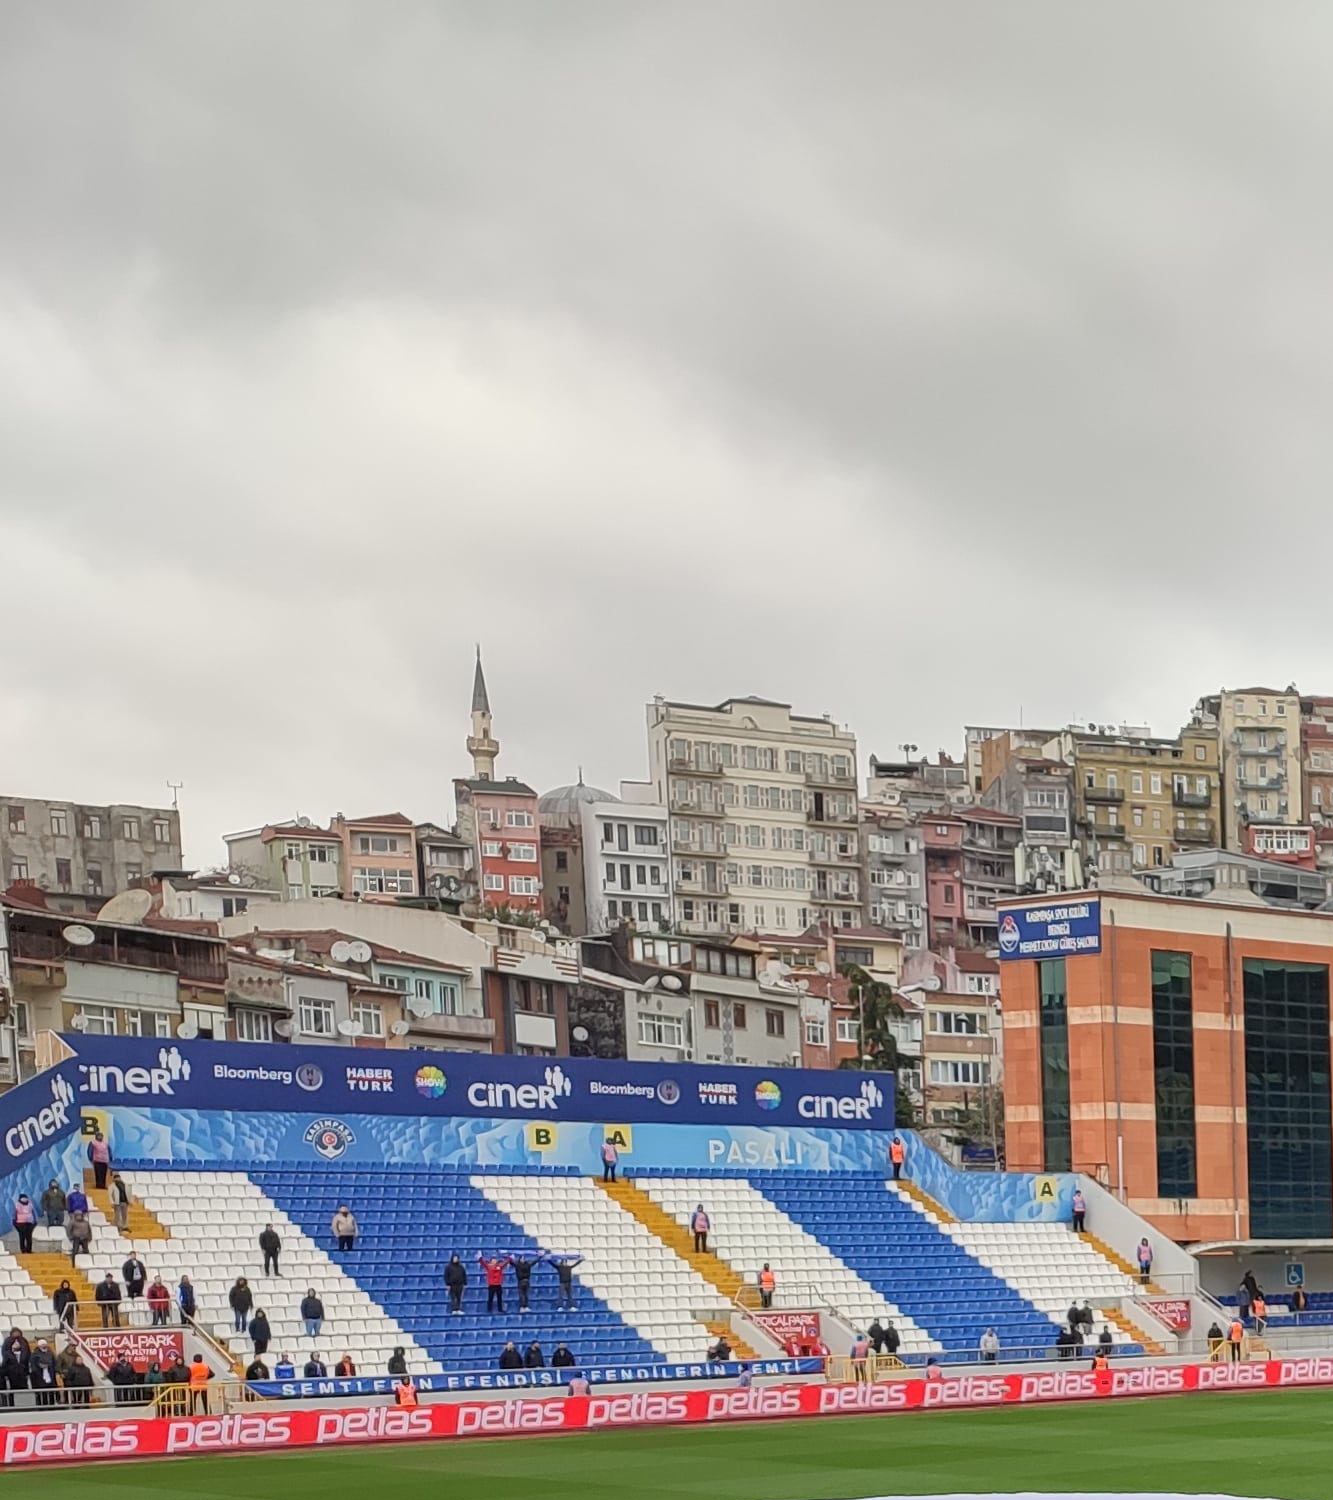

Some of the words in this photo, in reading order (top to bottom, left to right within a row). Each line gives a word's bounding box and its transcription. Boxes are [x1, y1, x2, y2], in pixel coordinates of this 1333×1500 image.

[214, 1064, 292, 1084] Bloomberg
[346, 1067, 393, 1080] HABER
[590, 1081, 655, 1099] Bloomberg
[81, 1115, 100, 1136] B
[535, 1128, 551, 1146] B
[612, 1130, 627, 1148] A
[1040, 1182, 1054, 1198] A
[923, 1374, 1006, 1407] petlas
[1020, 1368, 1088, 1402] petlas
[1113, 1363, 1185, 1396] petlas
[1202, 1360, 1267, 1390] petlas
[587, 1393, 688, 1428] petlas
[707, 1388, 802, 1420] petlas
[819, 1378, 908, 1412] petlas
[317, 1407, 433, 1443] petlas
[457, 1399, 565, 1436] petlas
[5, 1423, 139, 1463] petlas
[168, 1415, 292, 1453] petlas
